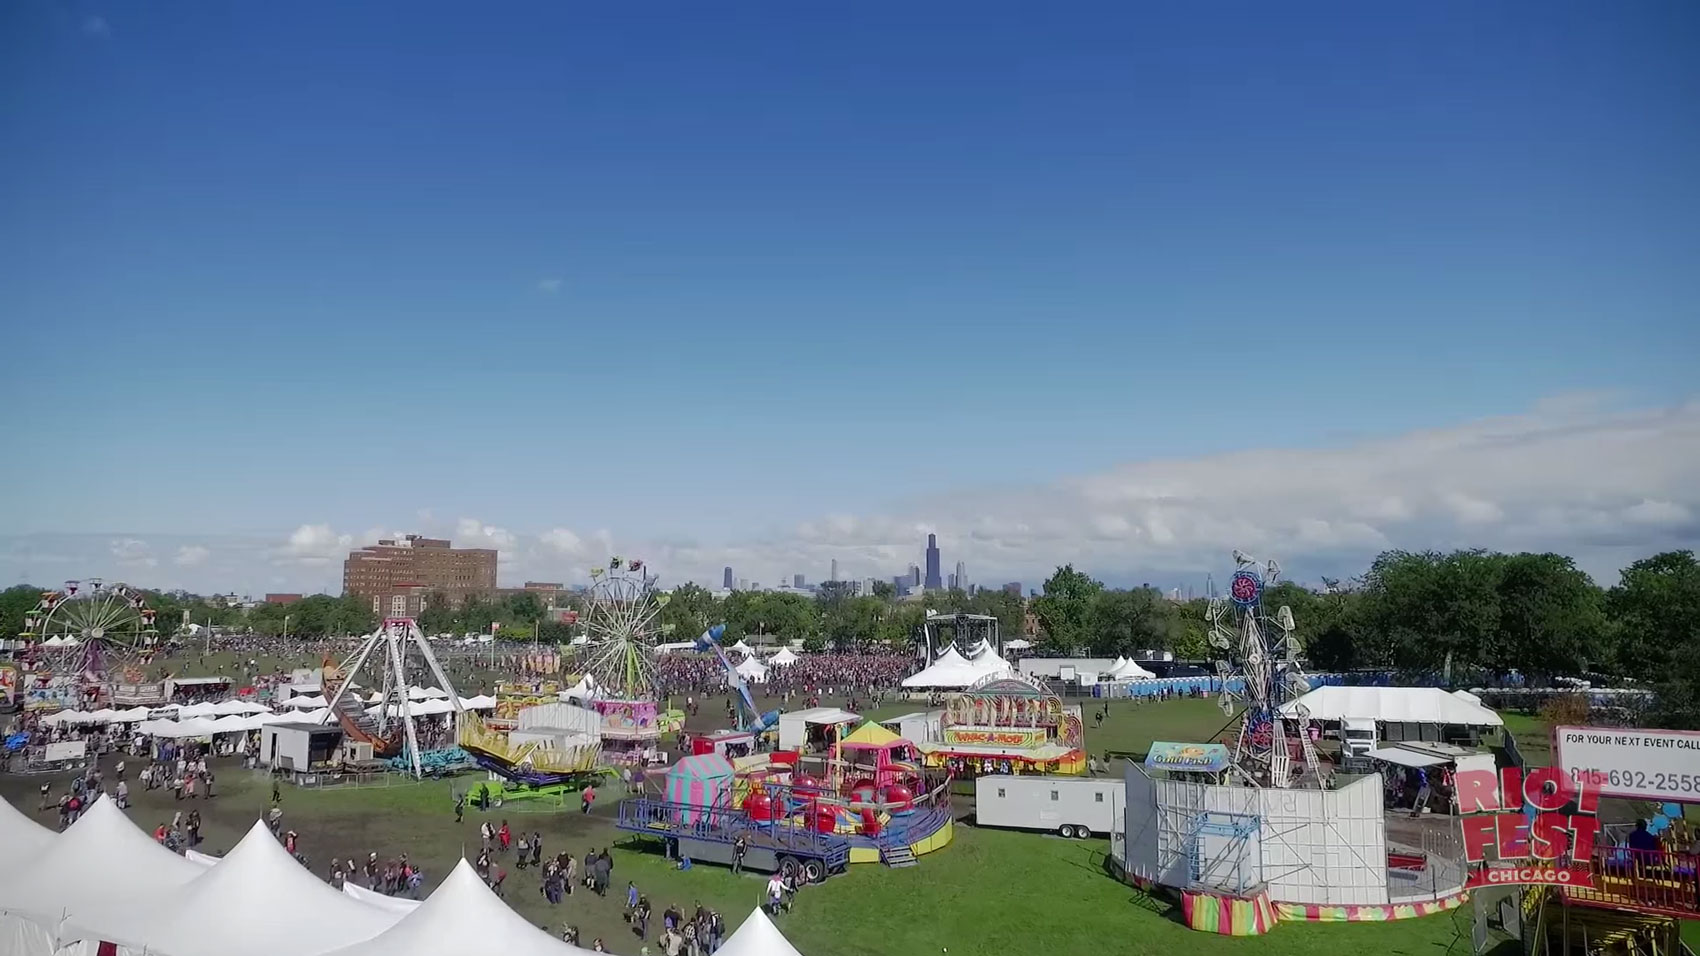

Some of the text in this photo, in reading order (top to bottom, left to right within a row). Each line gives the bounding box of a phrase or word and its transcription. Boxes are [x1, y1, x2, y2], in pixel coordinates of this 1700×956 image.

[1566, 733, 1584, 744] FOR
[1586, 734, 1612, 745] YOUR
[1614, 736, 1641, 747] NEXT
[1643, 737, 1675, 748] EVENT
